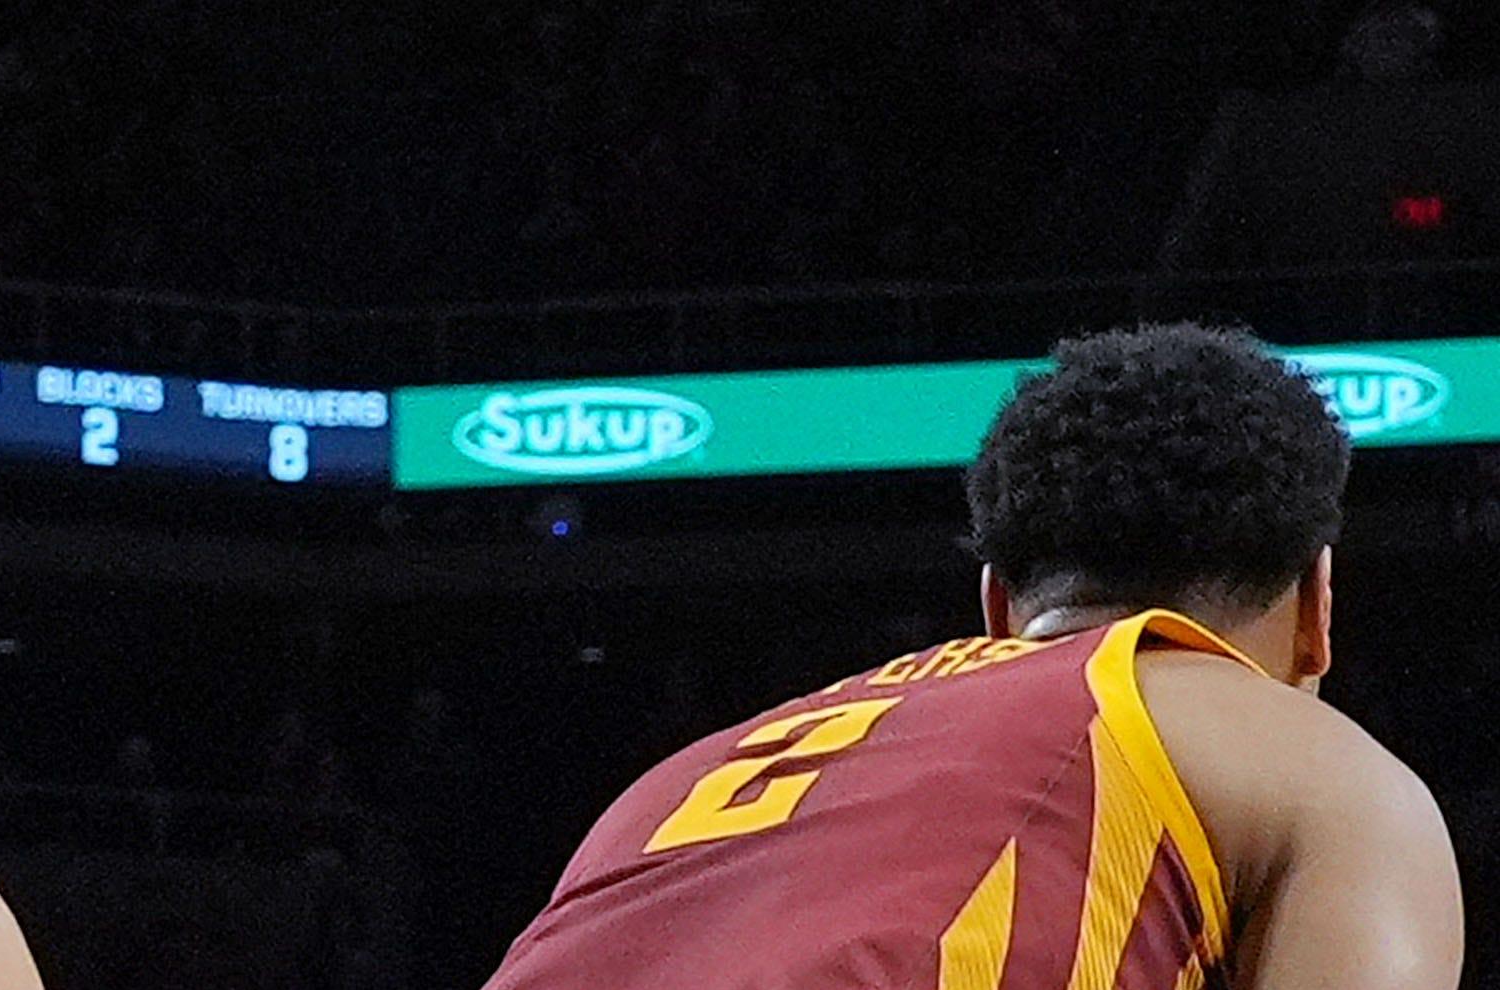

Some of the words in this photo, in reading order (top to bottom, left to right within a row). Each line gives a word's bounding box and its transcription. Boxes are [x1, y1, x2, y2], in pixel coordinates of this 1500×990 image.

[37, 365, 164, 412] BLOCKS
[197, 381, 388, 428] TURNOVERS
[81, 408, 120, 466] 2
[268, 424, 309, 482] 8
[477, 393, 686, 460] Sukup
[822, 636, 1068, 693] ERS
[642, 696, 904, 854] 2
